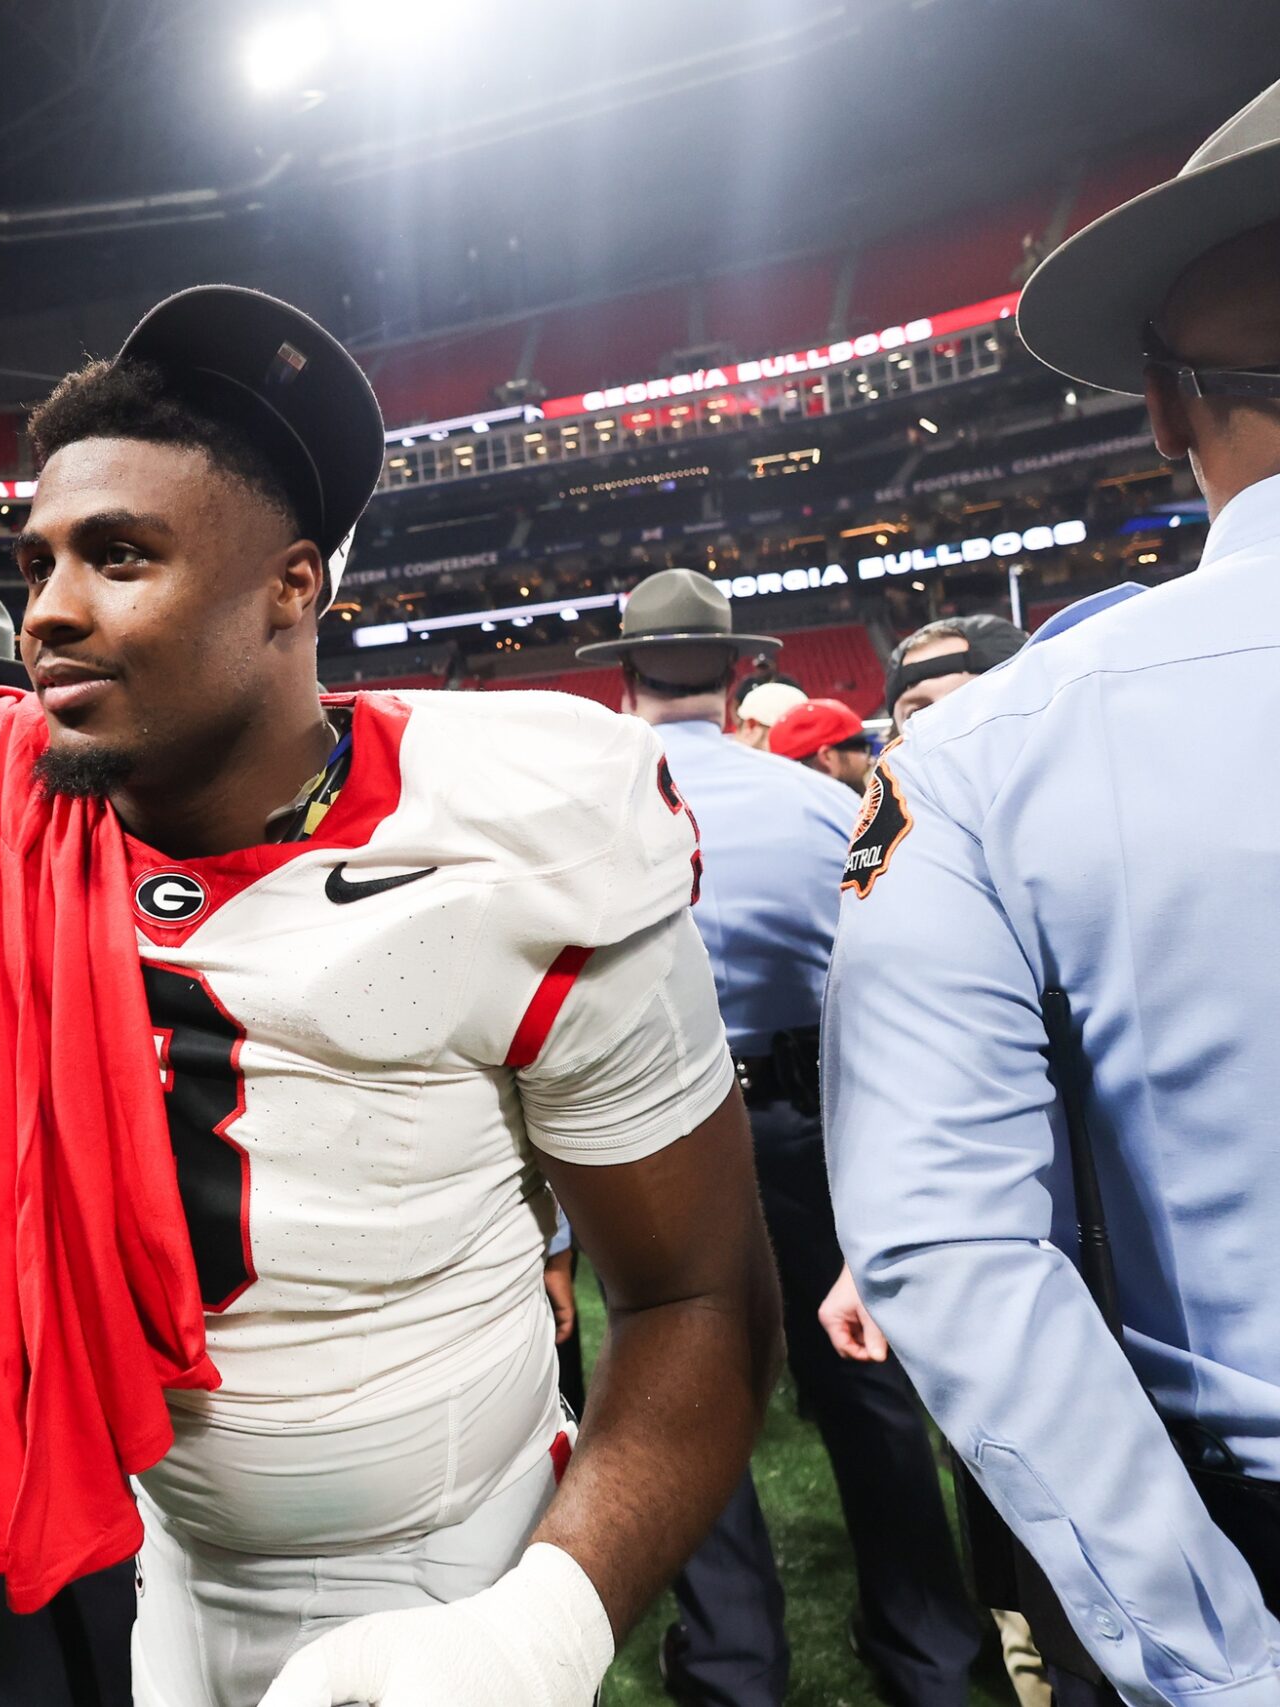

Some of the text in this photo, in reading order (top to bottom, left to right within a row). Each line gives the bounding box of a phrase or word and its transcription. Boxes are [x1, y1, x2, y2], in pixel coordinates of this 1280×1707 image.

[583, 318, 933, 411] GEORGIA BULLDOGS
[403, 551, 499, 579] CONFERENCE
[858, 520, 1087, 581] BULLDOGS
[135, 872, 206, 922] G
